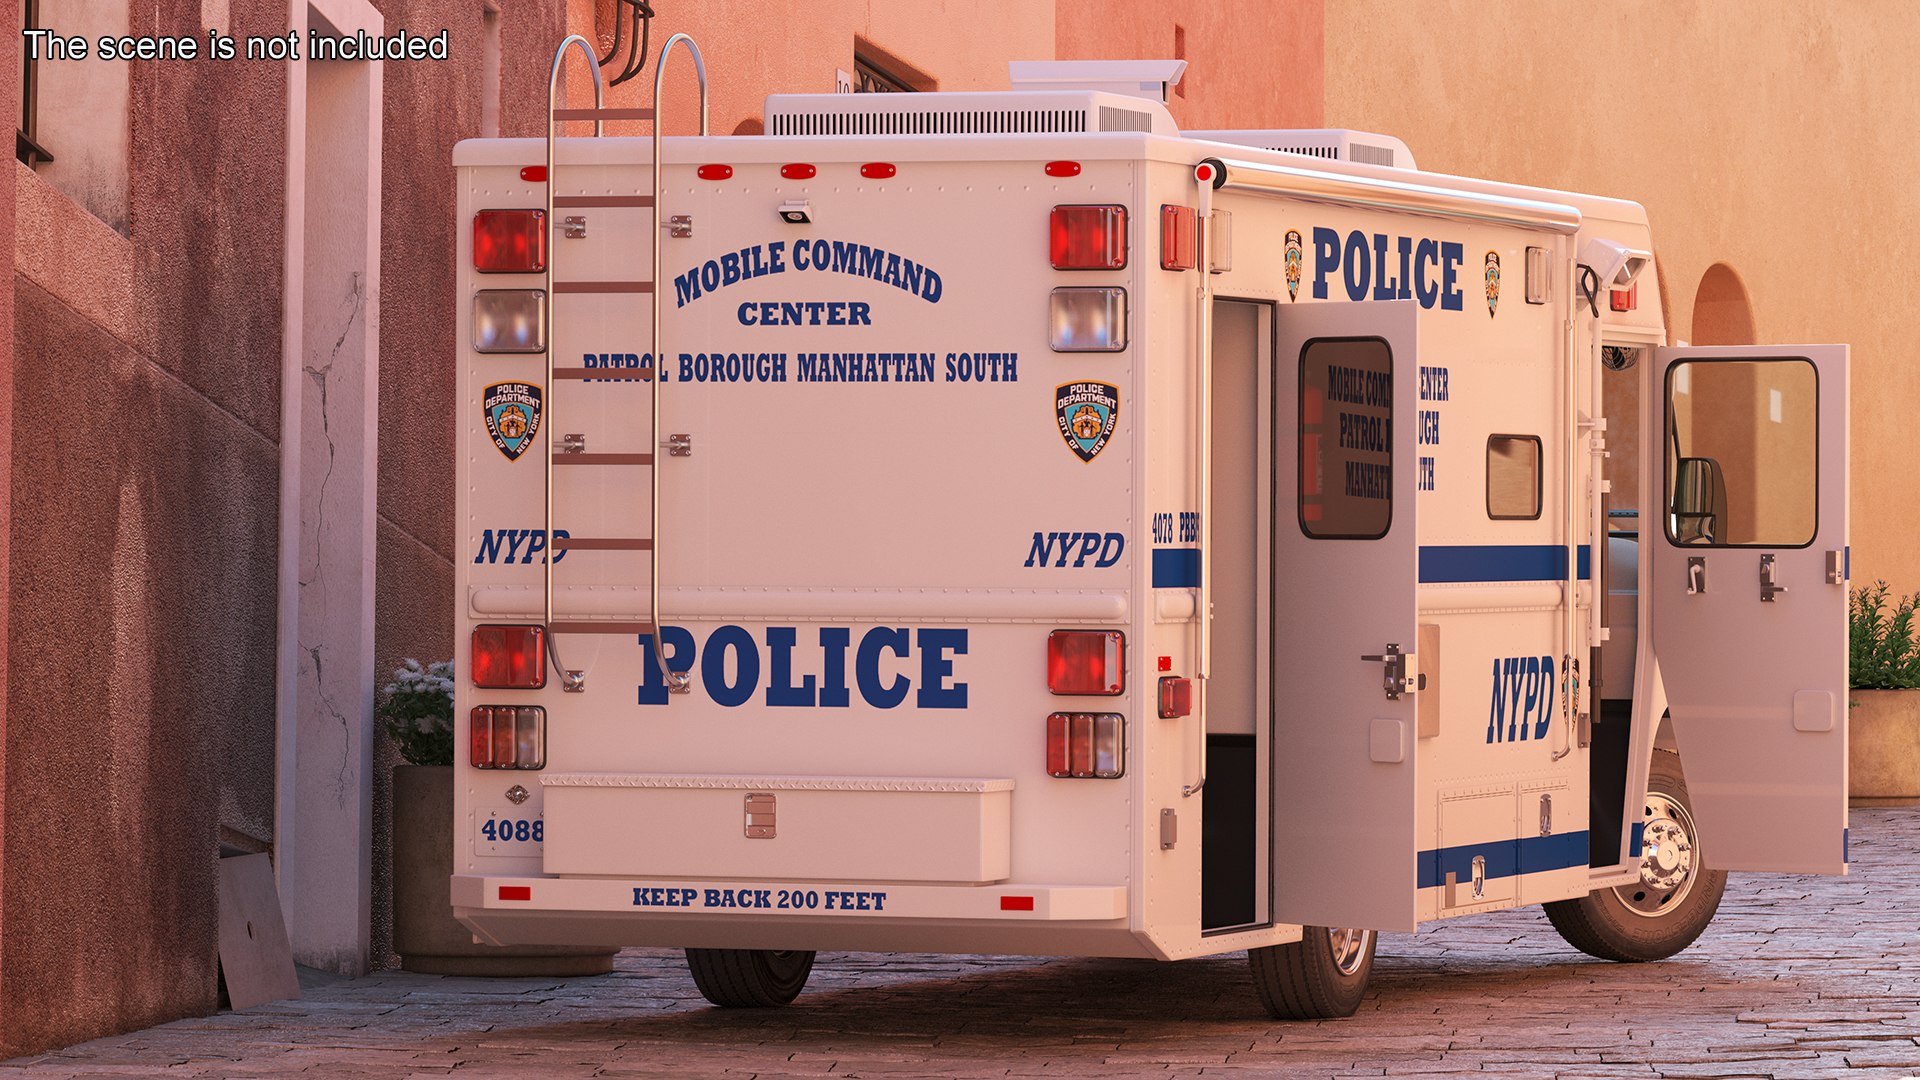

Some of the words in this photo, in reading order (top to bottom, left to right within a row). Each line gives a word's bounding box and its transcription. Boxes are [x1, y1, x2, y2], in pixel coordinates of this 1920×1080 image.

[674, 241, 786, 309] MOBILE
[793, 239, 943, 304] COMMAND
[1313, 227, 1463, 311] POLICE
[737, 302, 872, 326] CENTER
[678, 353, 786, 382] BOROUGH
[797, 353, 935, 382] MANHATTAN
[946, 352, 1018, 382] SOUTH
[1419, 366, 1448, 401] ENTER
[497, 384, 529, 395] POLICE
[1058, 393, 1117, 409] DEPARTMENT
[1070, 384, 1104, 394] POLICE
[1328, 365, 1364, 404] MOBILE
[485, 394, 541, 410] DEPARTMENT
[486, 416, 498, 437] CITY
[496, 439, 506, 450] OF
[516, 438, 531, 454] NEW
[529, 413, 540, 435] YORK
[1058, 416, 1071, 437] CITY
[1068, 440, 1079, 450] OF
[1090, 439, 1106, 455] NEW
[1104, 413, 1116, 435] YORK
[1340, 412, 1384, 452] PATROL
[1152, 512, 1173, 543] 4078
[1024, 532, 1125, 568] NYPD
[639, 625, 969, 709] POLICE
[1486, 655, 1555, 744] NYPD
[632, 887, 698, 907] KEEP
[704, 889, 771, 908] BACK
[777, 889, 819, 909] 200
[824, 891, 887, 911] FEET
